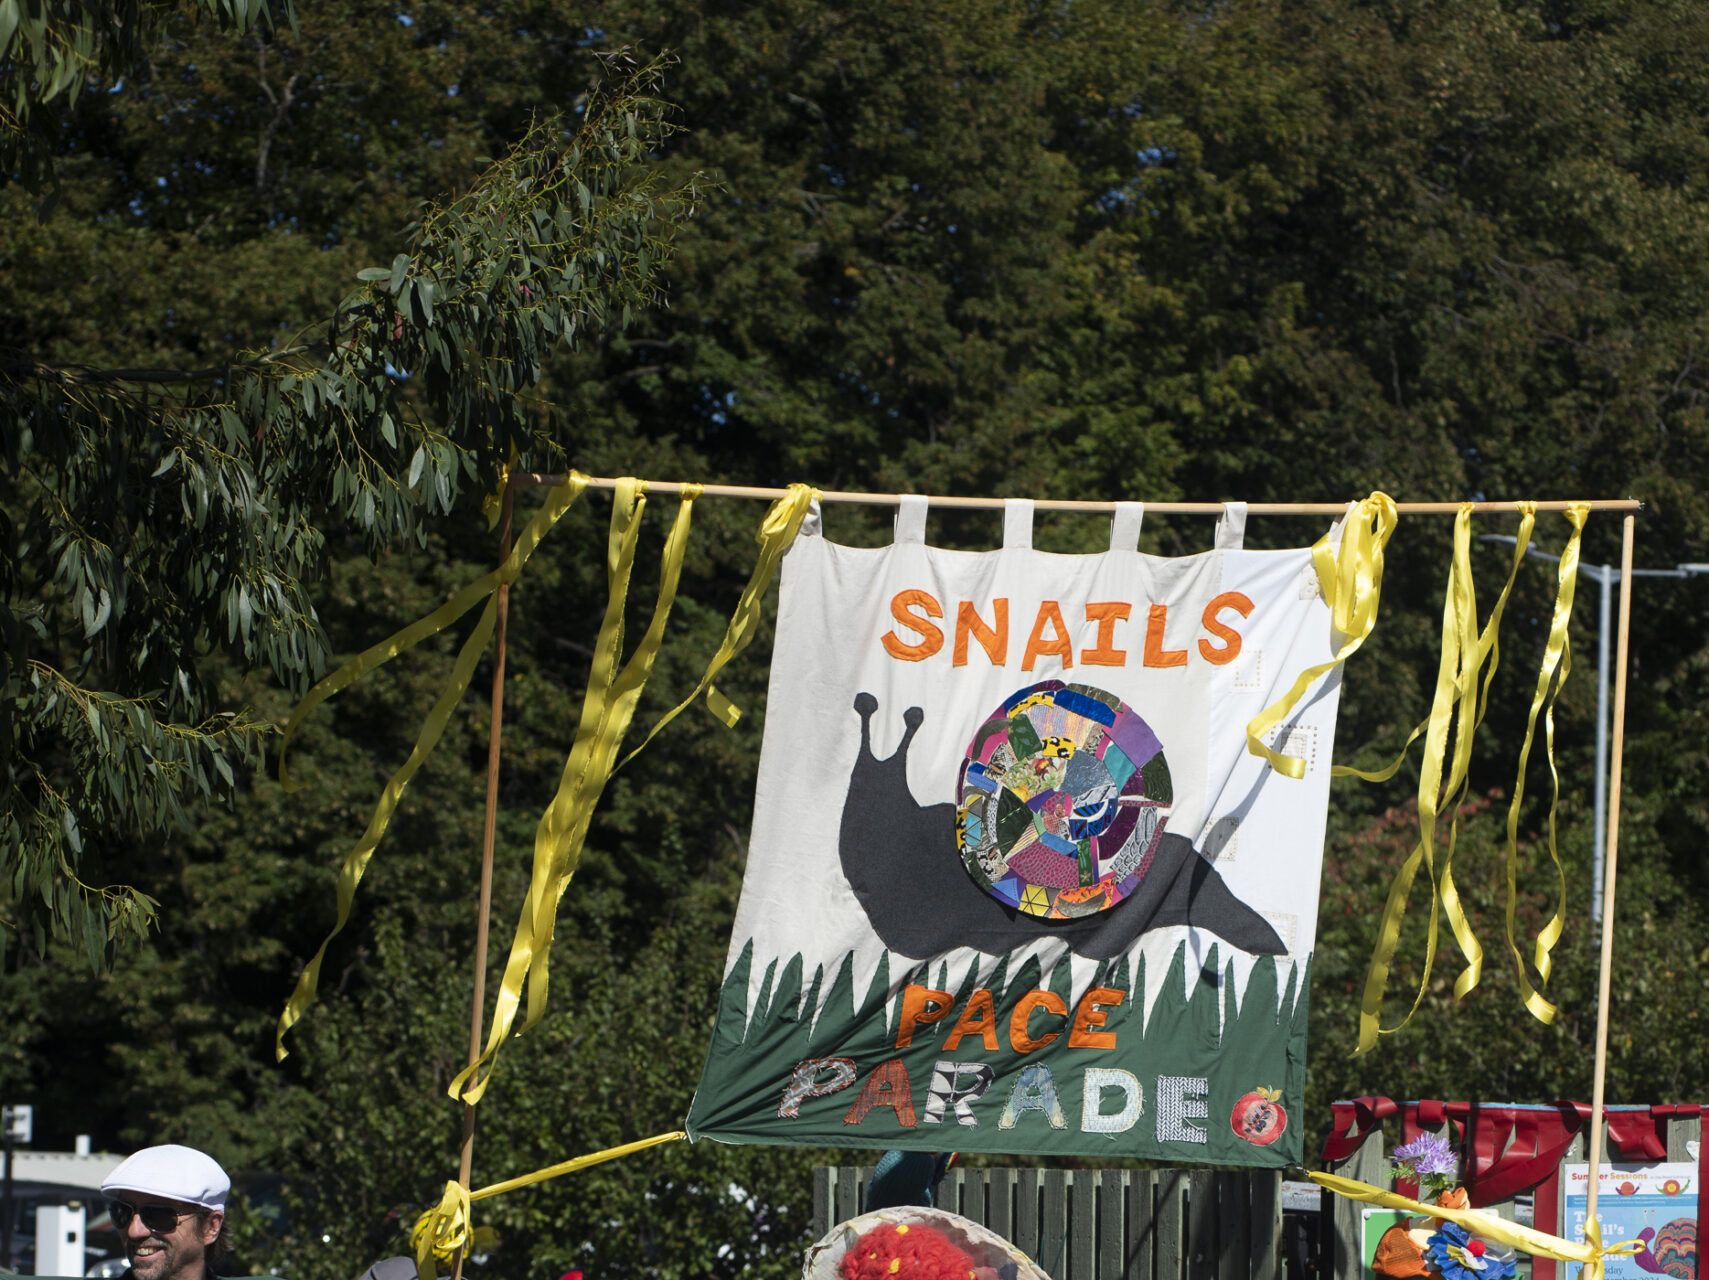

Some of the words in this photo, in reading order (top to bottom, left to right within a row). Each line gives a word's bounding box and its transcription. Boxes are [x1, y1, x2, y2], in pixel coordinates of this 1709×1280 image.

[880, 588, 1256, 672] SNAILS
[895, 984, 1127, 1054] PACE
[776, 1056, 1209, 1145] PARADE
[1571, 1172, 1608, 1181] Sumer
[1610, 1171, 1649, 1181] Sessions
[1573, 1210, 1604, 1223] Te
[1574, 1223, 1625, 1236] Sil's
